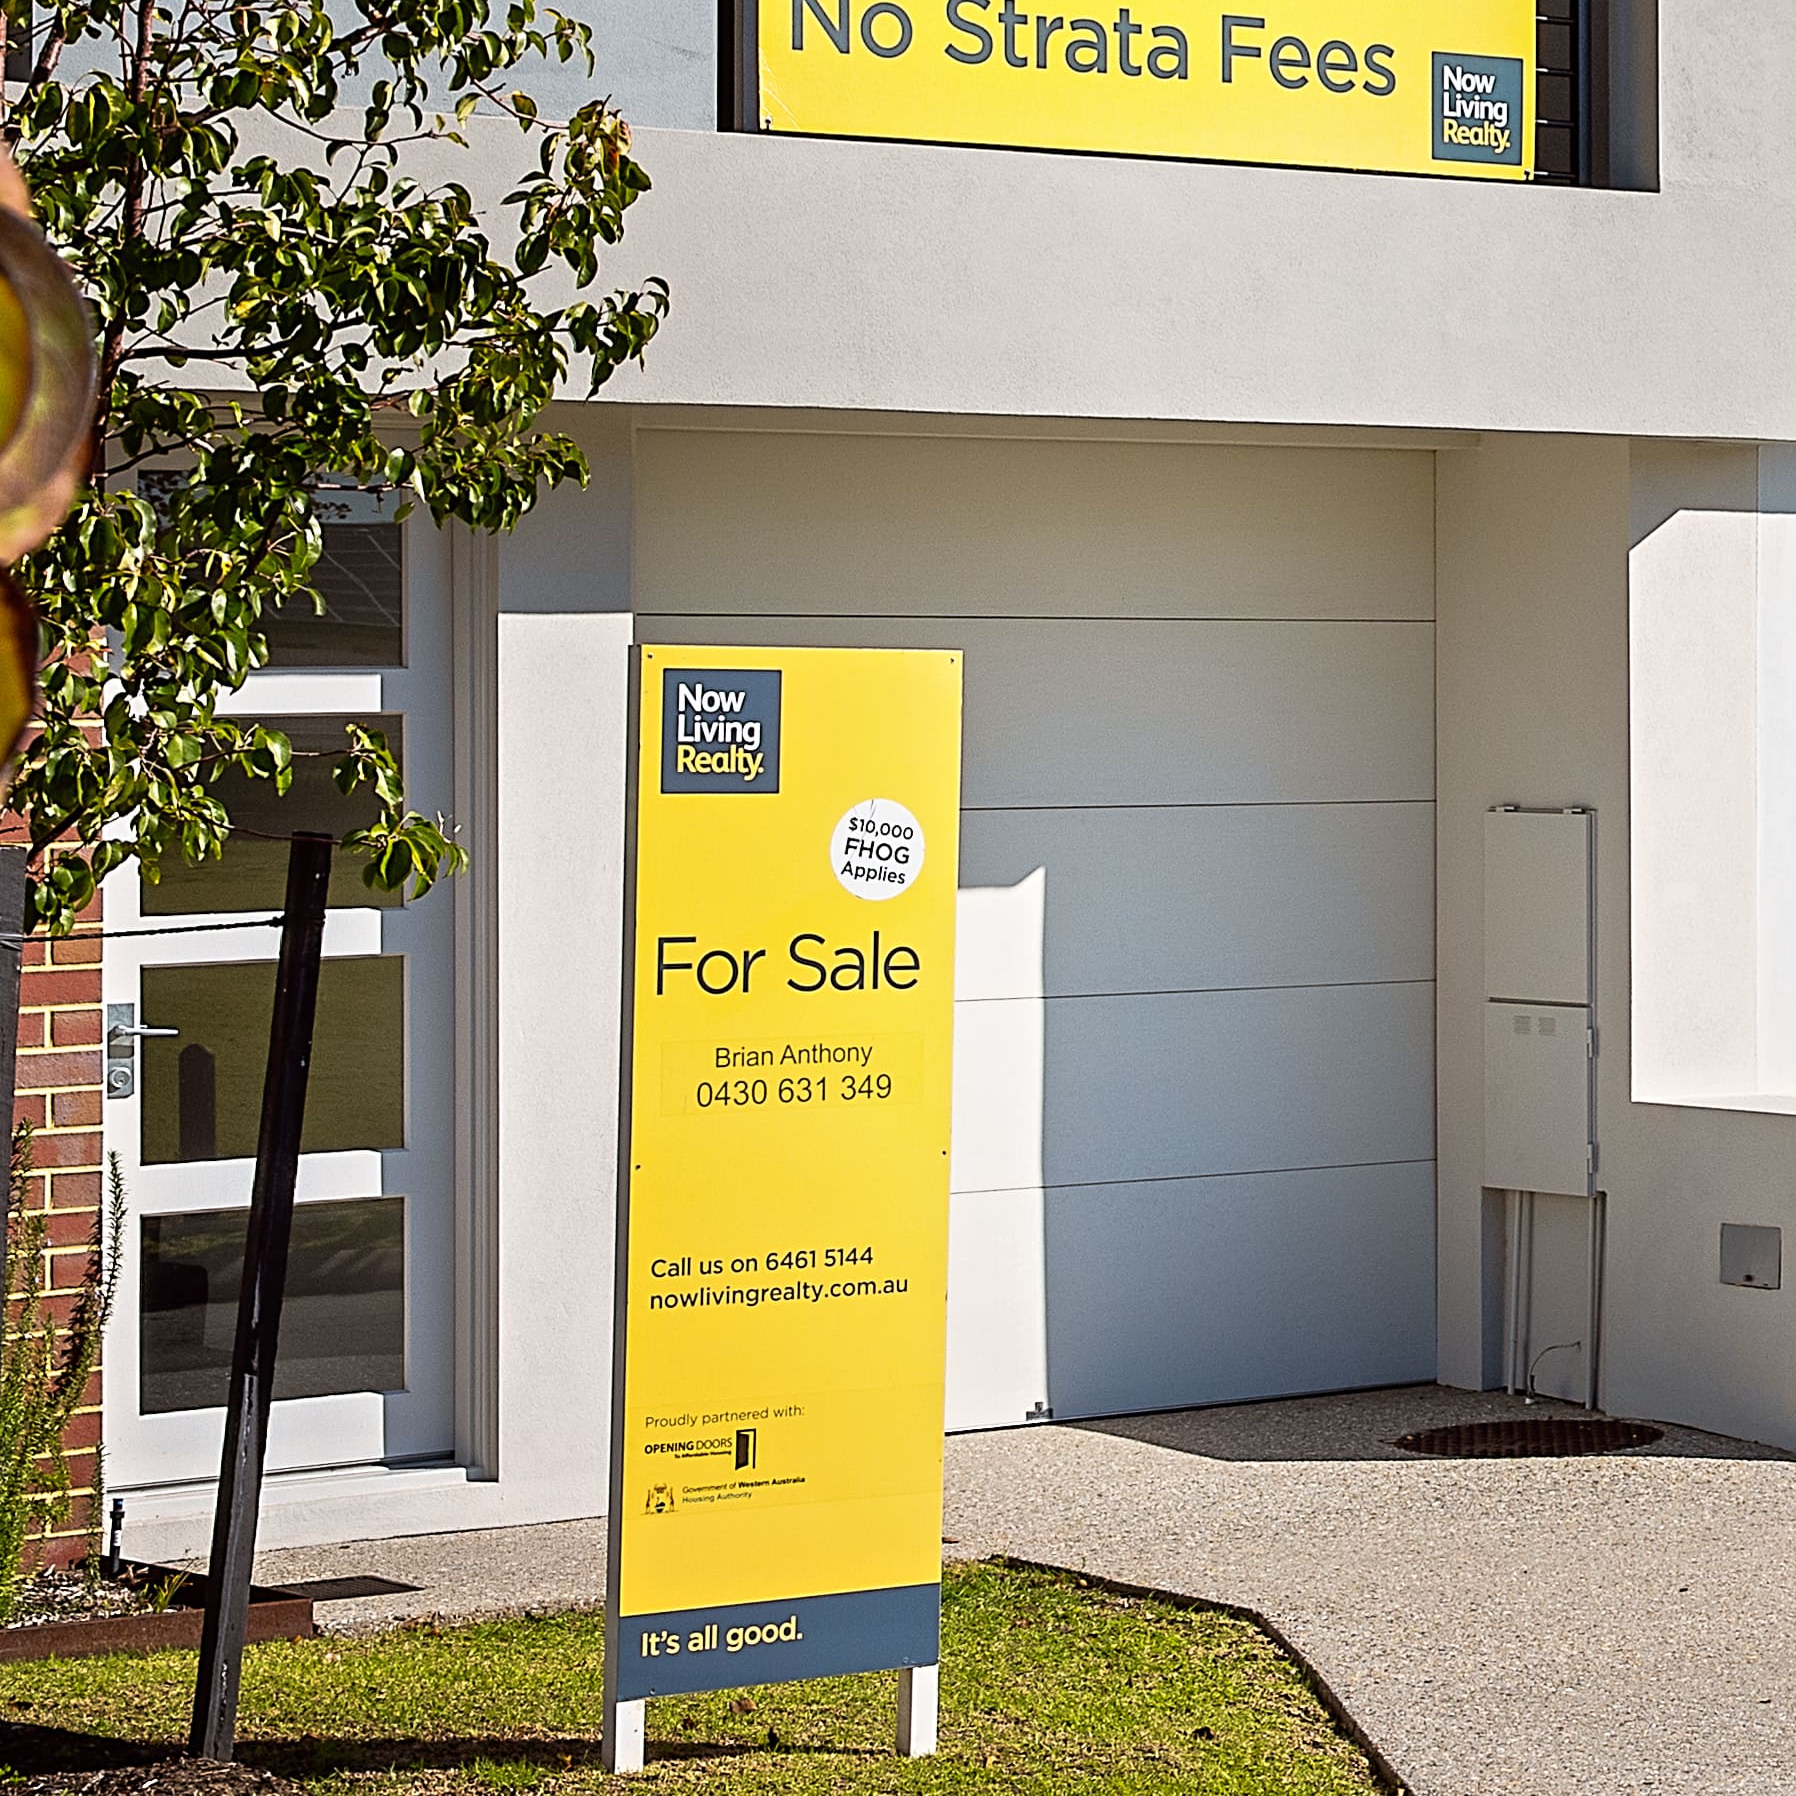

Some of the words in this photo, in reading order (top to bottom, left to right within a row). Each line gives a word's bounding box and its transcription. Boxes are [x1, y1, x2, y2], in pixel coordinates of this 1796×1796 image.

[1221, 14, 1397, 96] Fees
[1443, 65, 1495, 93] Now
[1443, 91, 1508, 128] Living
[1443, 118, 1511, 154] Realty.
[678, 683, 745, 713] Now
[678, 714, 761, 750] Living
[676, 744, 764, 780] Realty.
[849, 817, 914, 841] $10,000
[845, 838, 910, 865] FHOG
[841, 860, 906, 885] Applies
[657, 936, 766, 995] For
[788, 931, 920, 992] Sale
[715, 1046, 773, 1068] Brian
[780, 1045, 873, 1067] Anthony
[697, 1079, 767, 1107] 0430
[779, 1077, 828, 1103] 631
[841, 1074, 892, 1100] 349
[651, 1257, 691, 1278] Call
[700, 1259, 723, 1275] us
[731, 1256, 757, 1273] on
[766, 1250, 816, 1271] 6461
[824, 1247, 873, 1267] 5144
[650, 1278, 908, 1310] nowlivingrealty.com.au
[645, 1413, 698, 1428] Proudly
[702, 1407, 769, 1425] partnered
[773, 1405, 805, 1418] with:
[644, 1440, 694, 1454] OPENING
[696, 1437, 733, 1450] DOORS
[682, 1483, 727, 1493] Government
[729, 1482, 737, 1490] of
[738, 1479, 769, 1488] Western
[772, 1477, 806, 1485] Australia
[641, 1630, 681, 1657] It's
[687, 1624, 718, 1651] all
[726, 1615, 803, 1653] good.
